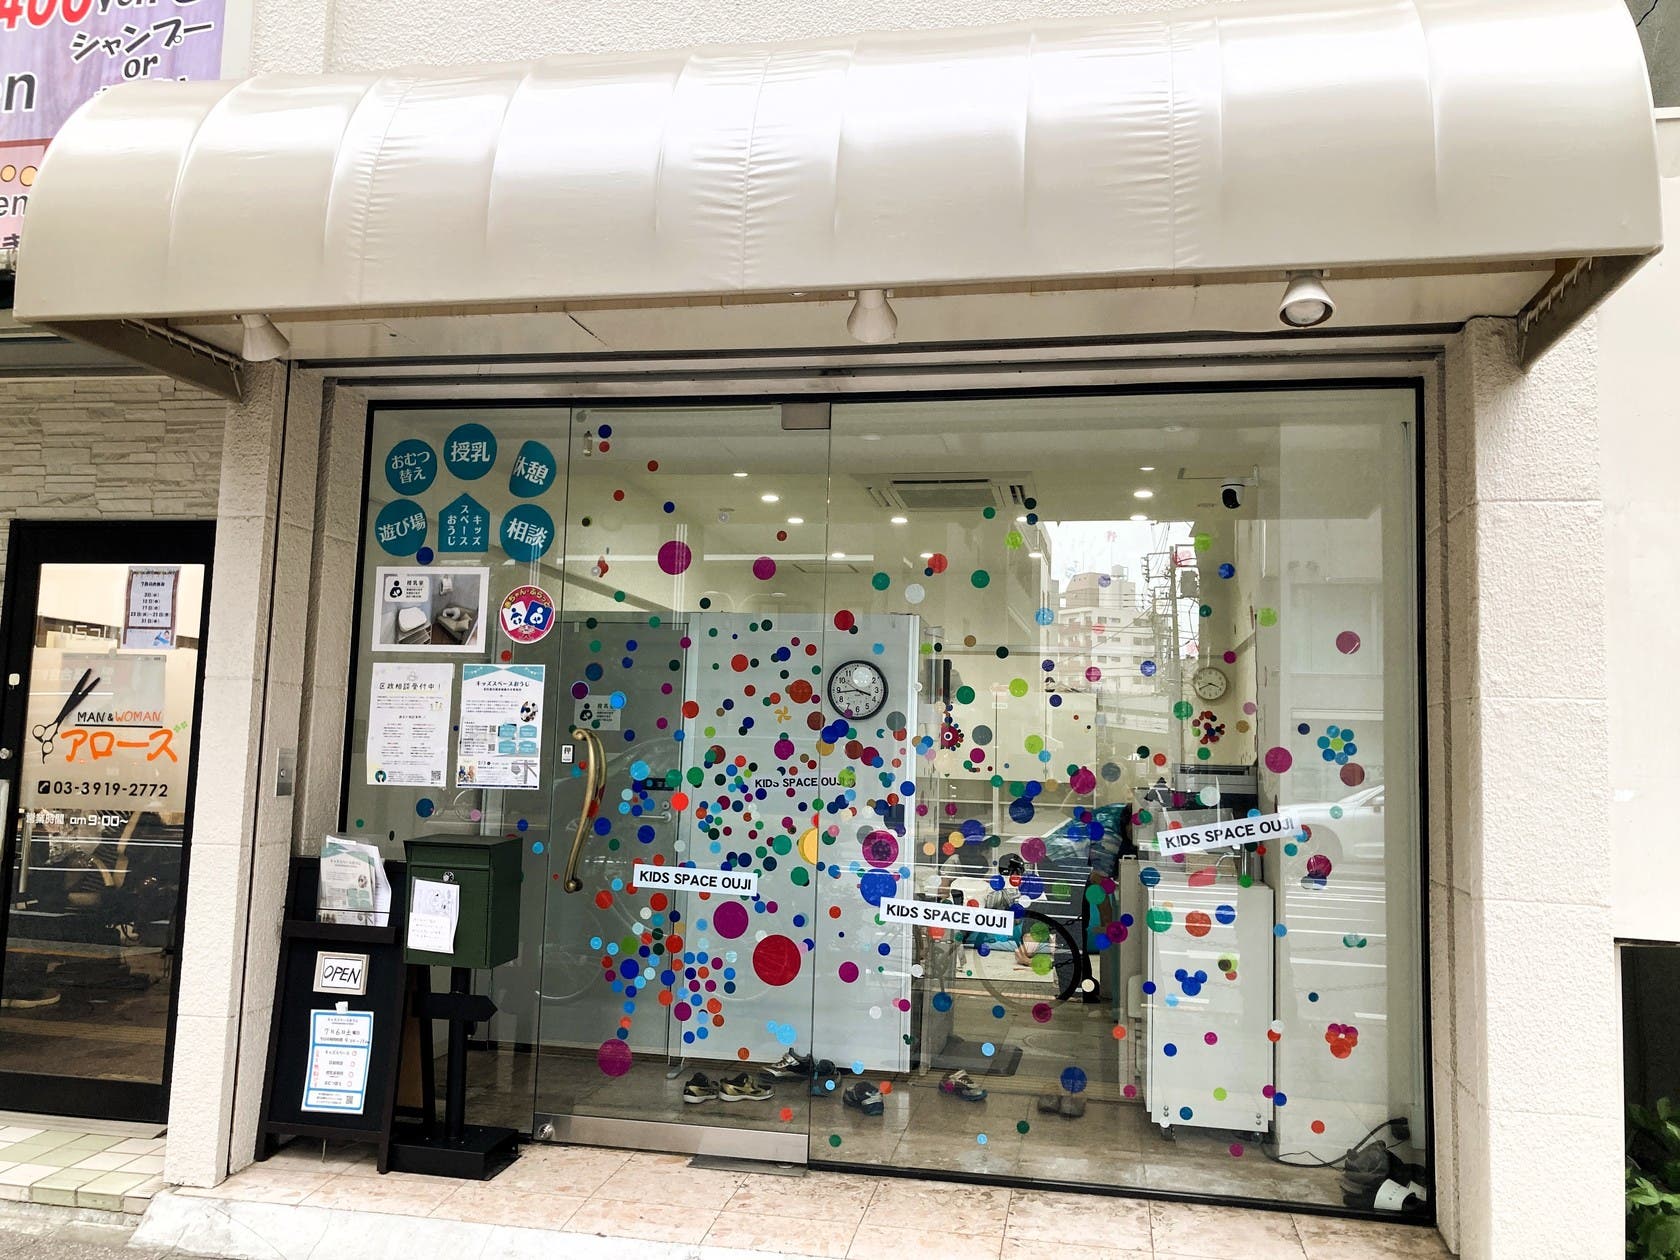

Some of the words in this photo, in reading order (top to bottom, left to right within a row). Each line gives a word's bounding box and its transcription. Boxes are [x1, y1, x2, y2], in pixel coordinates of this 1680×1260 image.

[73, 18, 212, 61] シャンプー
[124, 55, 159, 79] or
[391, 450, 431, 470] おむつ
[450, 441, 490, 463] 授乳
[400, 466, 426, 484] 替え
[378, 512, 426, 543] 遊び場
[447, 515, 457, 546] おうじ
[459, 504, 469, 546] スペース
[472, 515, 482, 546] キッズ
[506, 517, 548, 548] 相談
[53, 781, 168, 797] 03-3919-2772
[782, 777, 818, 787] SPACE
[1165, 832, 1200, 849] KIDS
[1204, 824, 1256, 842] SPACE
[1260, 818, 1295, 834] OUJI
[639, 870, 670, 884] KIDS
[673, 873, 718, 887] SPACE
[721, 877, 752, 890] OUJI
[886, 904, 919, 919] KIDS
[923, 908, 971, 924] SPACE
[974, 914, 1007, 928] OUJI
[323, 965, 361, 984] OPEN
